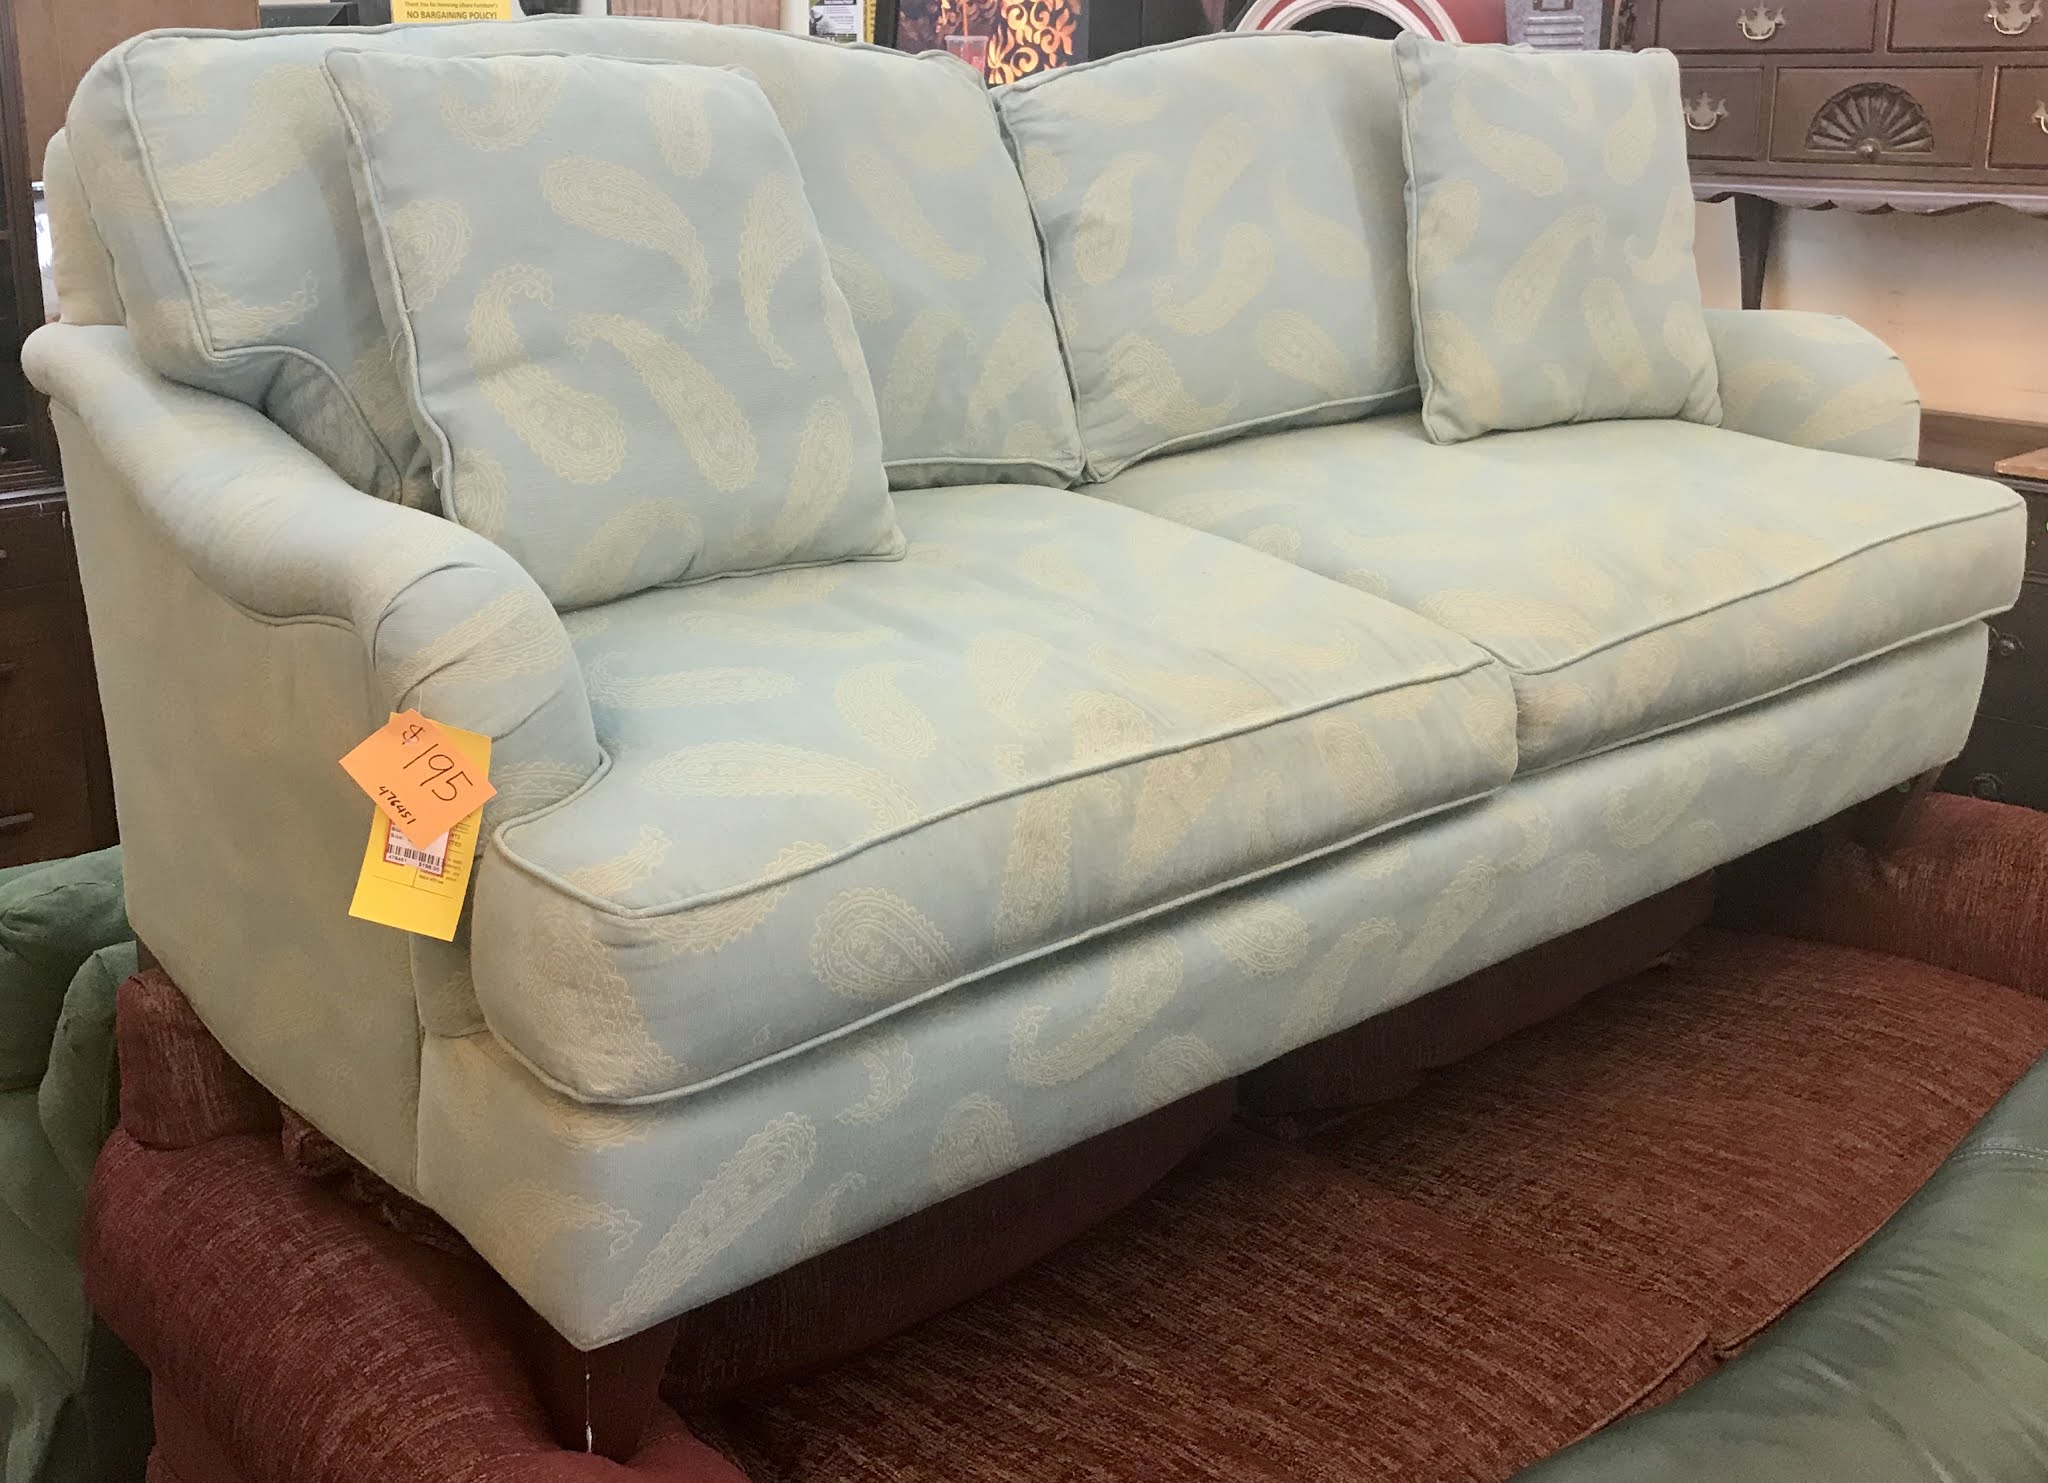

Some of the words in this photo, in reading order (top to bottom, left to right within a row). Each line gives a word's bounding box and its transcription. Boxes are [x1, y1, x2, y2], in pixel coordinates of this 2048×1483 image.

[406, 11, 419, 19] NO
[420, 11, 467, 19] BARGAINING
[469, 11, 498, 20] POLICY!
[379, 786, 416, 825] 476451
